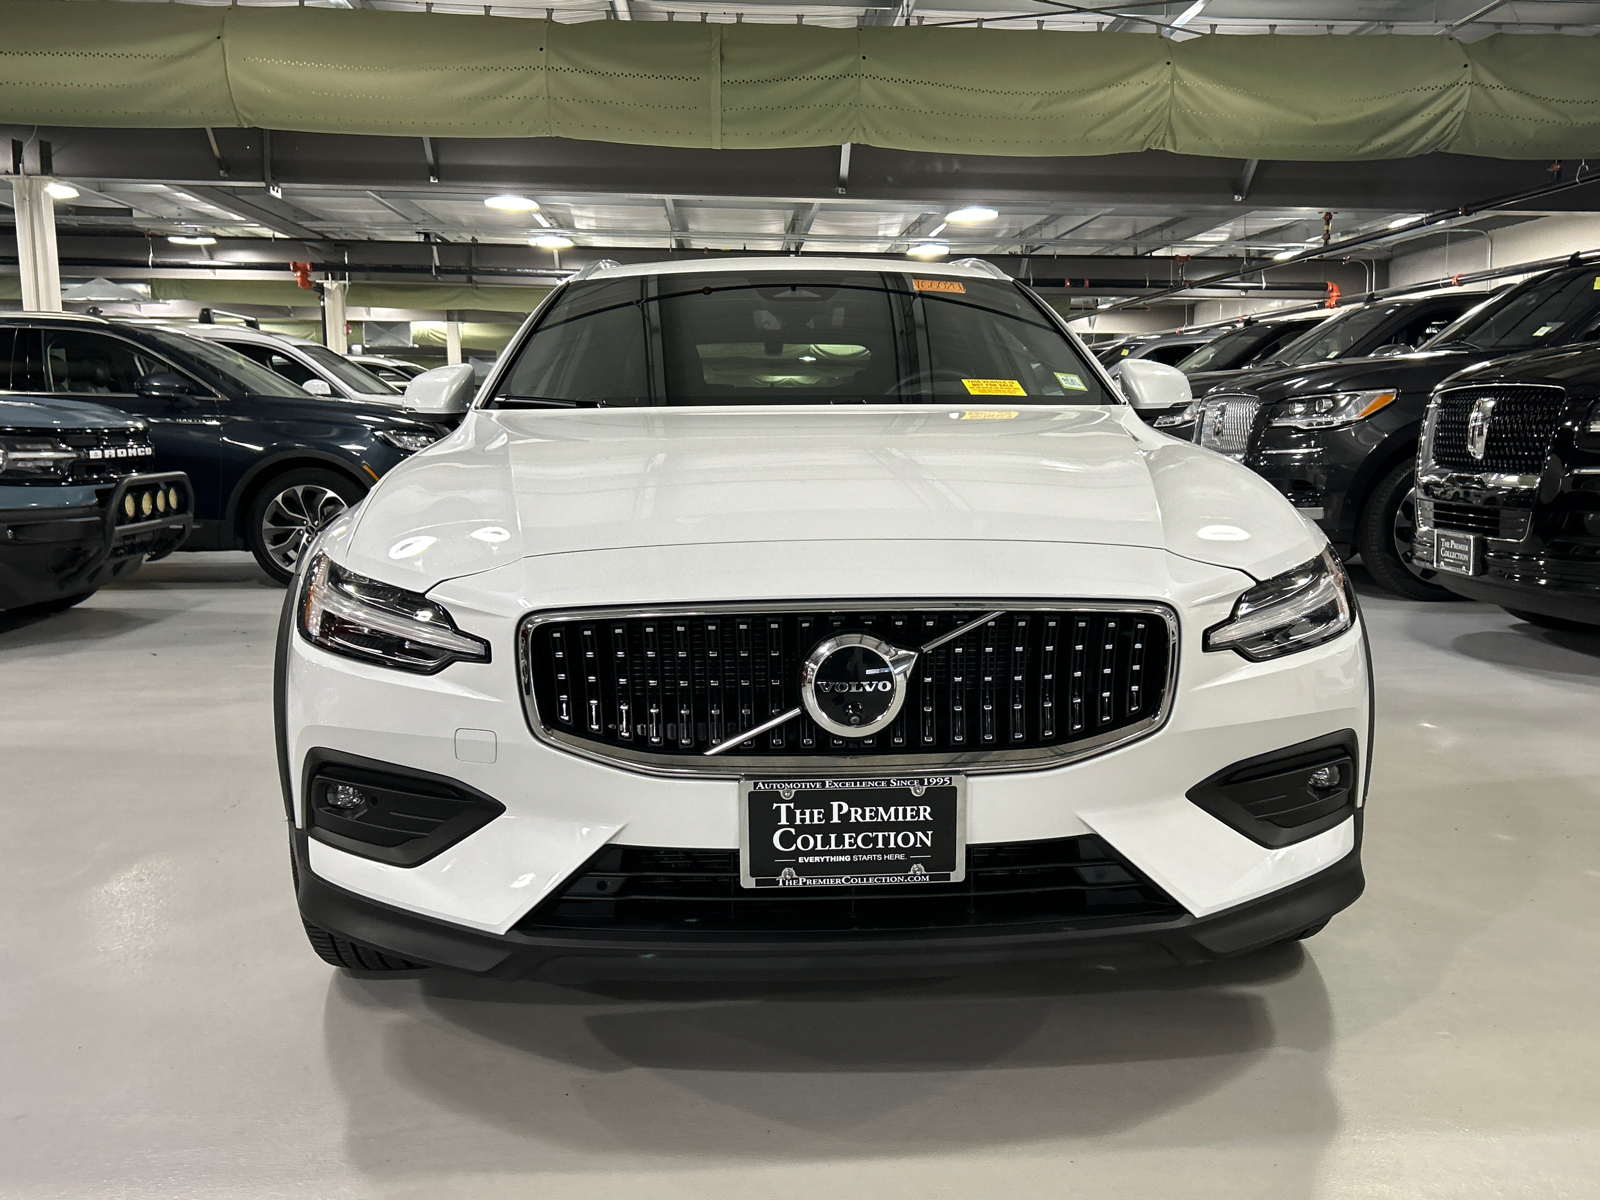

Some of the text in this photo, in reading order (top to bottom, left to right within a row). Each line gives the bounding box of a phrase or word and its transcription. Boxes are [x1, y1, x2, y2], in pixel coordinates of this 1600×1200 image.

[89, 447, 152, 459] BRONCO
[1440, 538, 1468, 551] THE PREMIER
[1440, 548, 1468, 560] COLLECTION
[816, 680, 892, 693] VOLVO
[755, 777, 951, 790] AUTOMOTIVE EXCELLENCE SINCE 1995
[772, 801, 933, 826] THE PREMIER
[772, 827, 933, 852] COLLECTION
[798, 853, 908, 863] EVERYTHING STARTS HERE.
